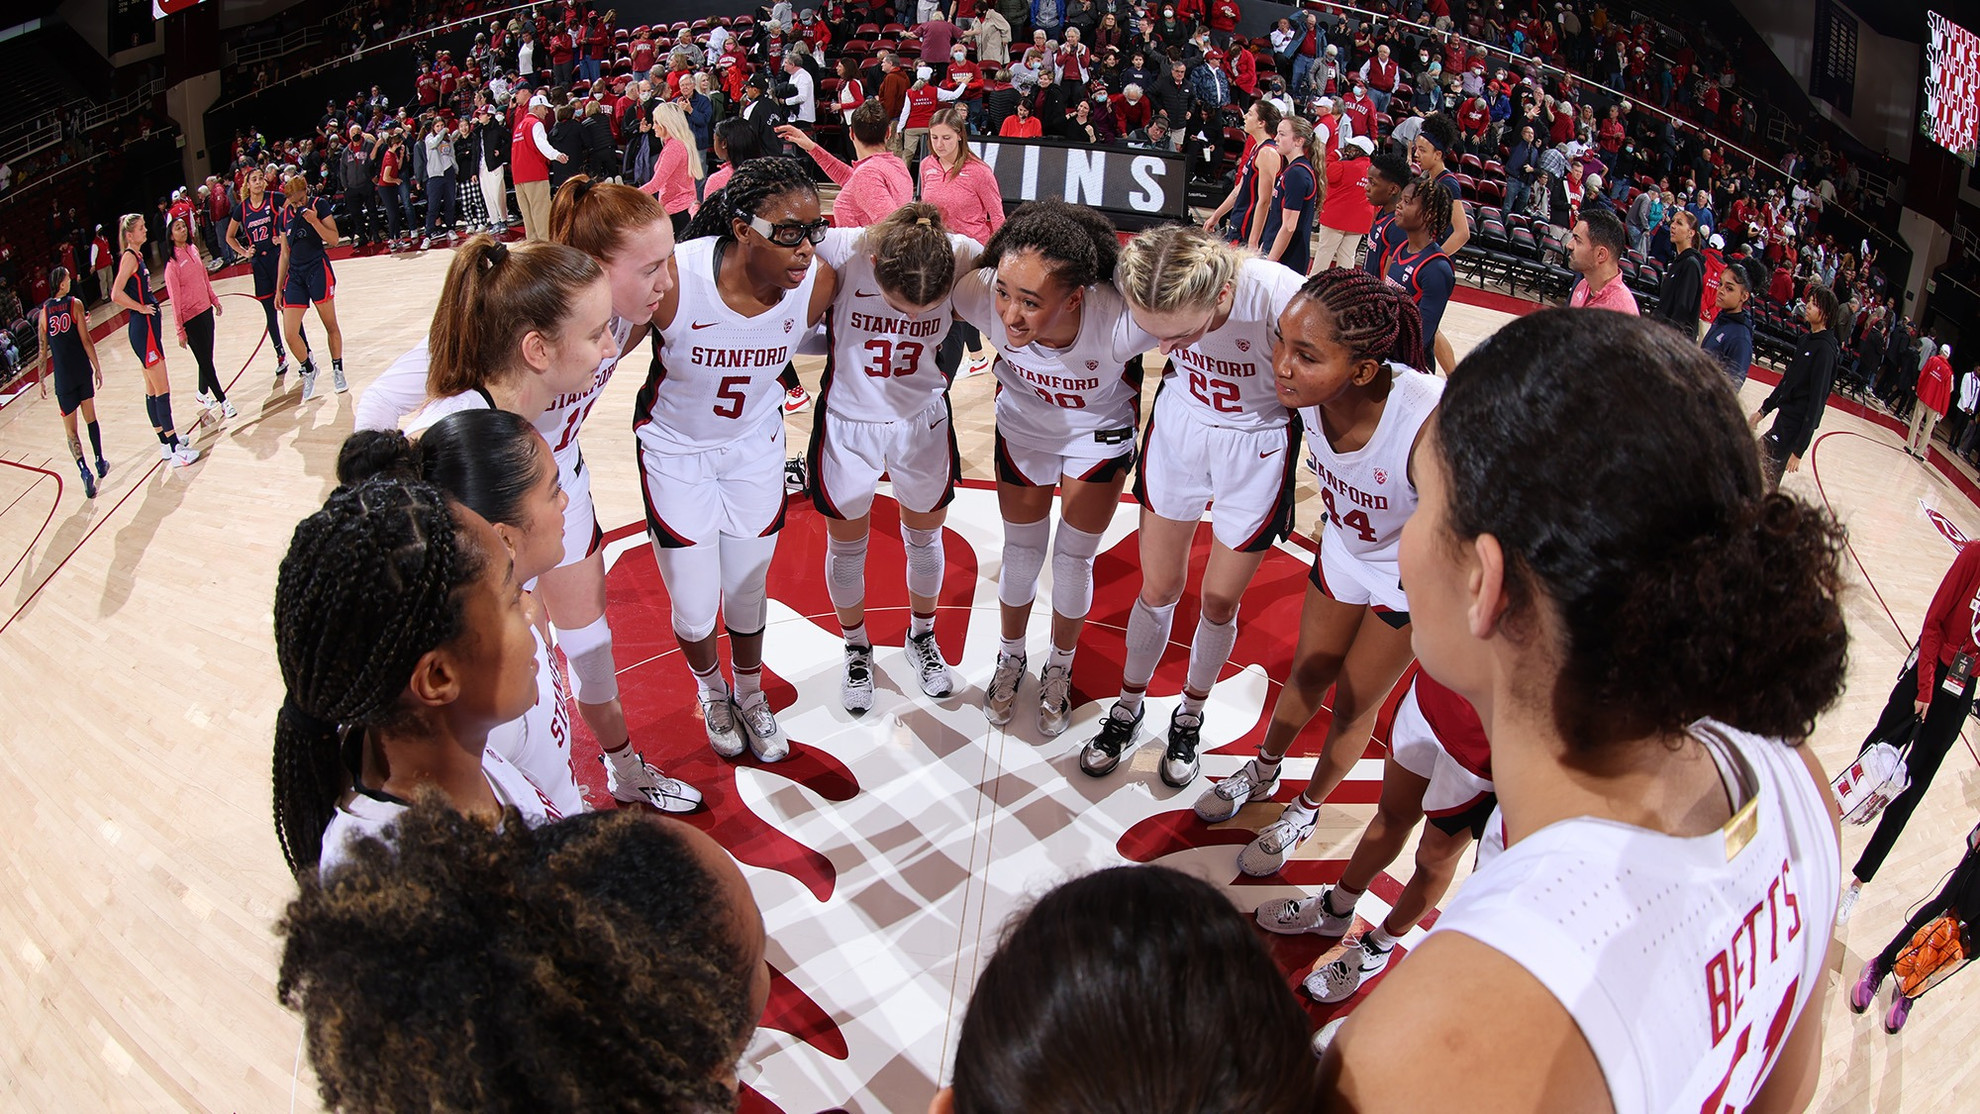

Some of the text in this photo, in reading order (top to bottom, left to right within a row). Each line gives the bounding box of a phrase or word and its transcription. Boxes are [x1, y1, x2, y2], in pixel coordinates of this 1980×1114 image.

[1927, 10, 1980, 56] STANFORD
[1931, 28, 1977, 69] WINS
[1926, 43, 1980, 90] STANFORD
[1930, 61, 1976, 103] WINS
[1924, 76, 1978, 123] STANFORD
[1928, 94, 1973, 139] WINS
[252, 225, 269, 243] 12
[49, 312, 71, 337] 30
[851, 312, 942, 338] STANFORD
[691, 346, 788, 368] STANFORD
[863, 339, 924, 379] 33
[1008, 359, 1099, 392] STANFORD
[1173, 349, 1256, 378] TANFORD
[713, 376, 751, 420] 5
[1184, 366, 1243, 413] 22
[553, 397, 597, 453] 11
[1321, 486, 1378, 543] 44
[1705, 858, 1801, 1050] BETTS
